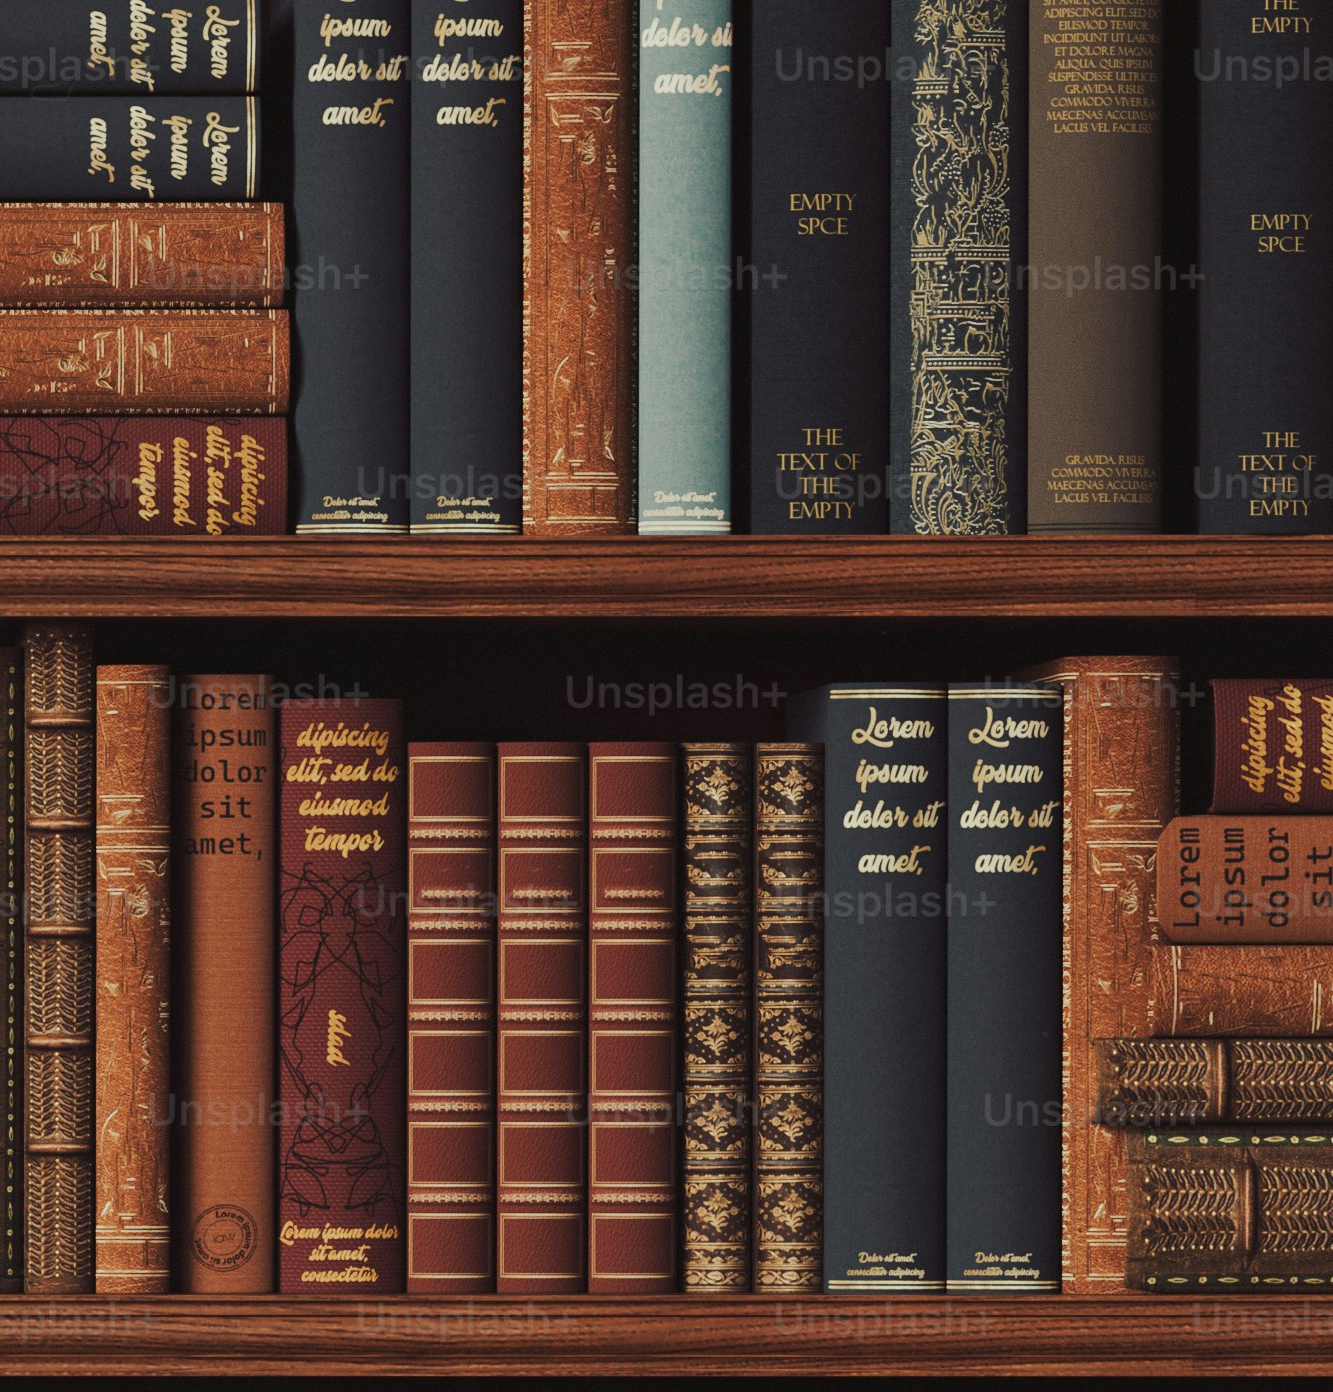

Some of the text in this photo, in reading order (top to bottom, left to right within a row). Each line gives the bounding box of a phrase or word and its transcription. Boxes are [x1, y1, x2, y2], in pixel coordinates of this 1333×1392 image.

[88, 118, 115, 182] amet,
[130, 106, 156, 198] dolor sit
[161, 116, 192, 180] ipsum
[203, 112, 240, 185] Lorem
[790, 194, 853, 211] EMPTY
[798, 217, 847, 235] SPCE
[802, 428, 842, 446] THE
[777, 453, 860, 471] TEXT OF
[798, 477, 839, 494] THE
[789, 502, 853, 519] EMPTY
[296, 722, 388, 755] dipiscing
[851, 707, 934, 748] Lorem
[286, 756, 398, 785] elit, sed do
[856, 759, 928, 793] ipsum
[298, 791, 389, 817] eiusmod
[843, 800, 944, 828] dolor sit
[305, 825, 384, 858] tempor
[858, 846, 930, 874] amet,
[326, 1009, 351, 1066] sdad
